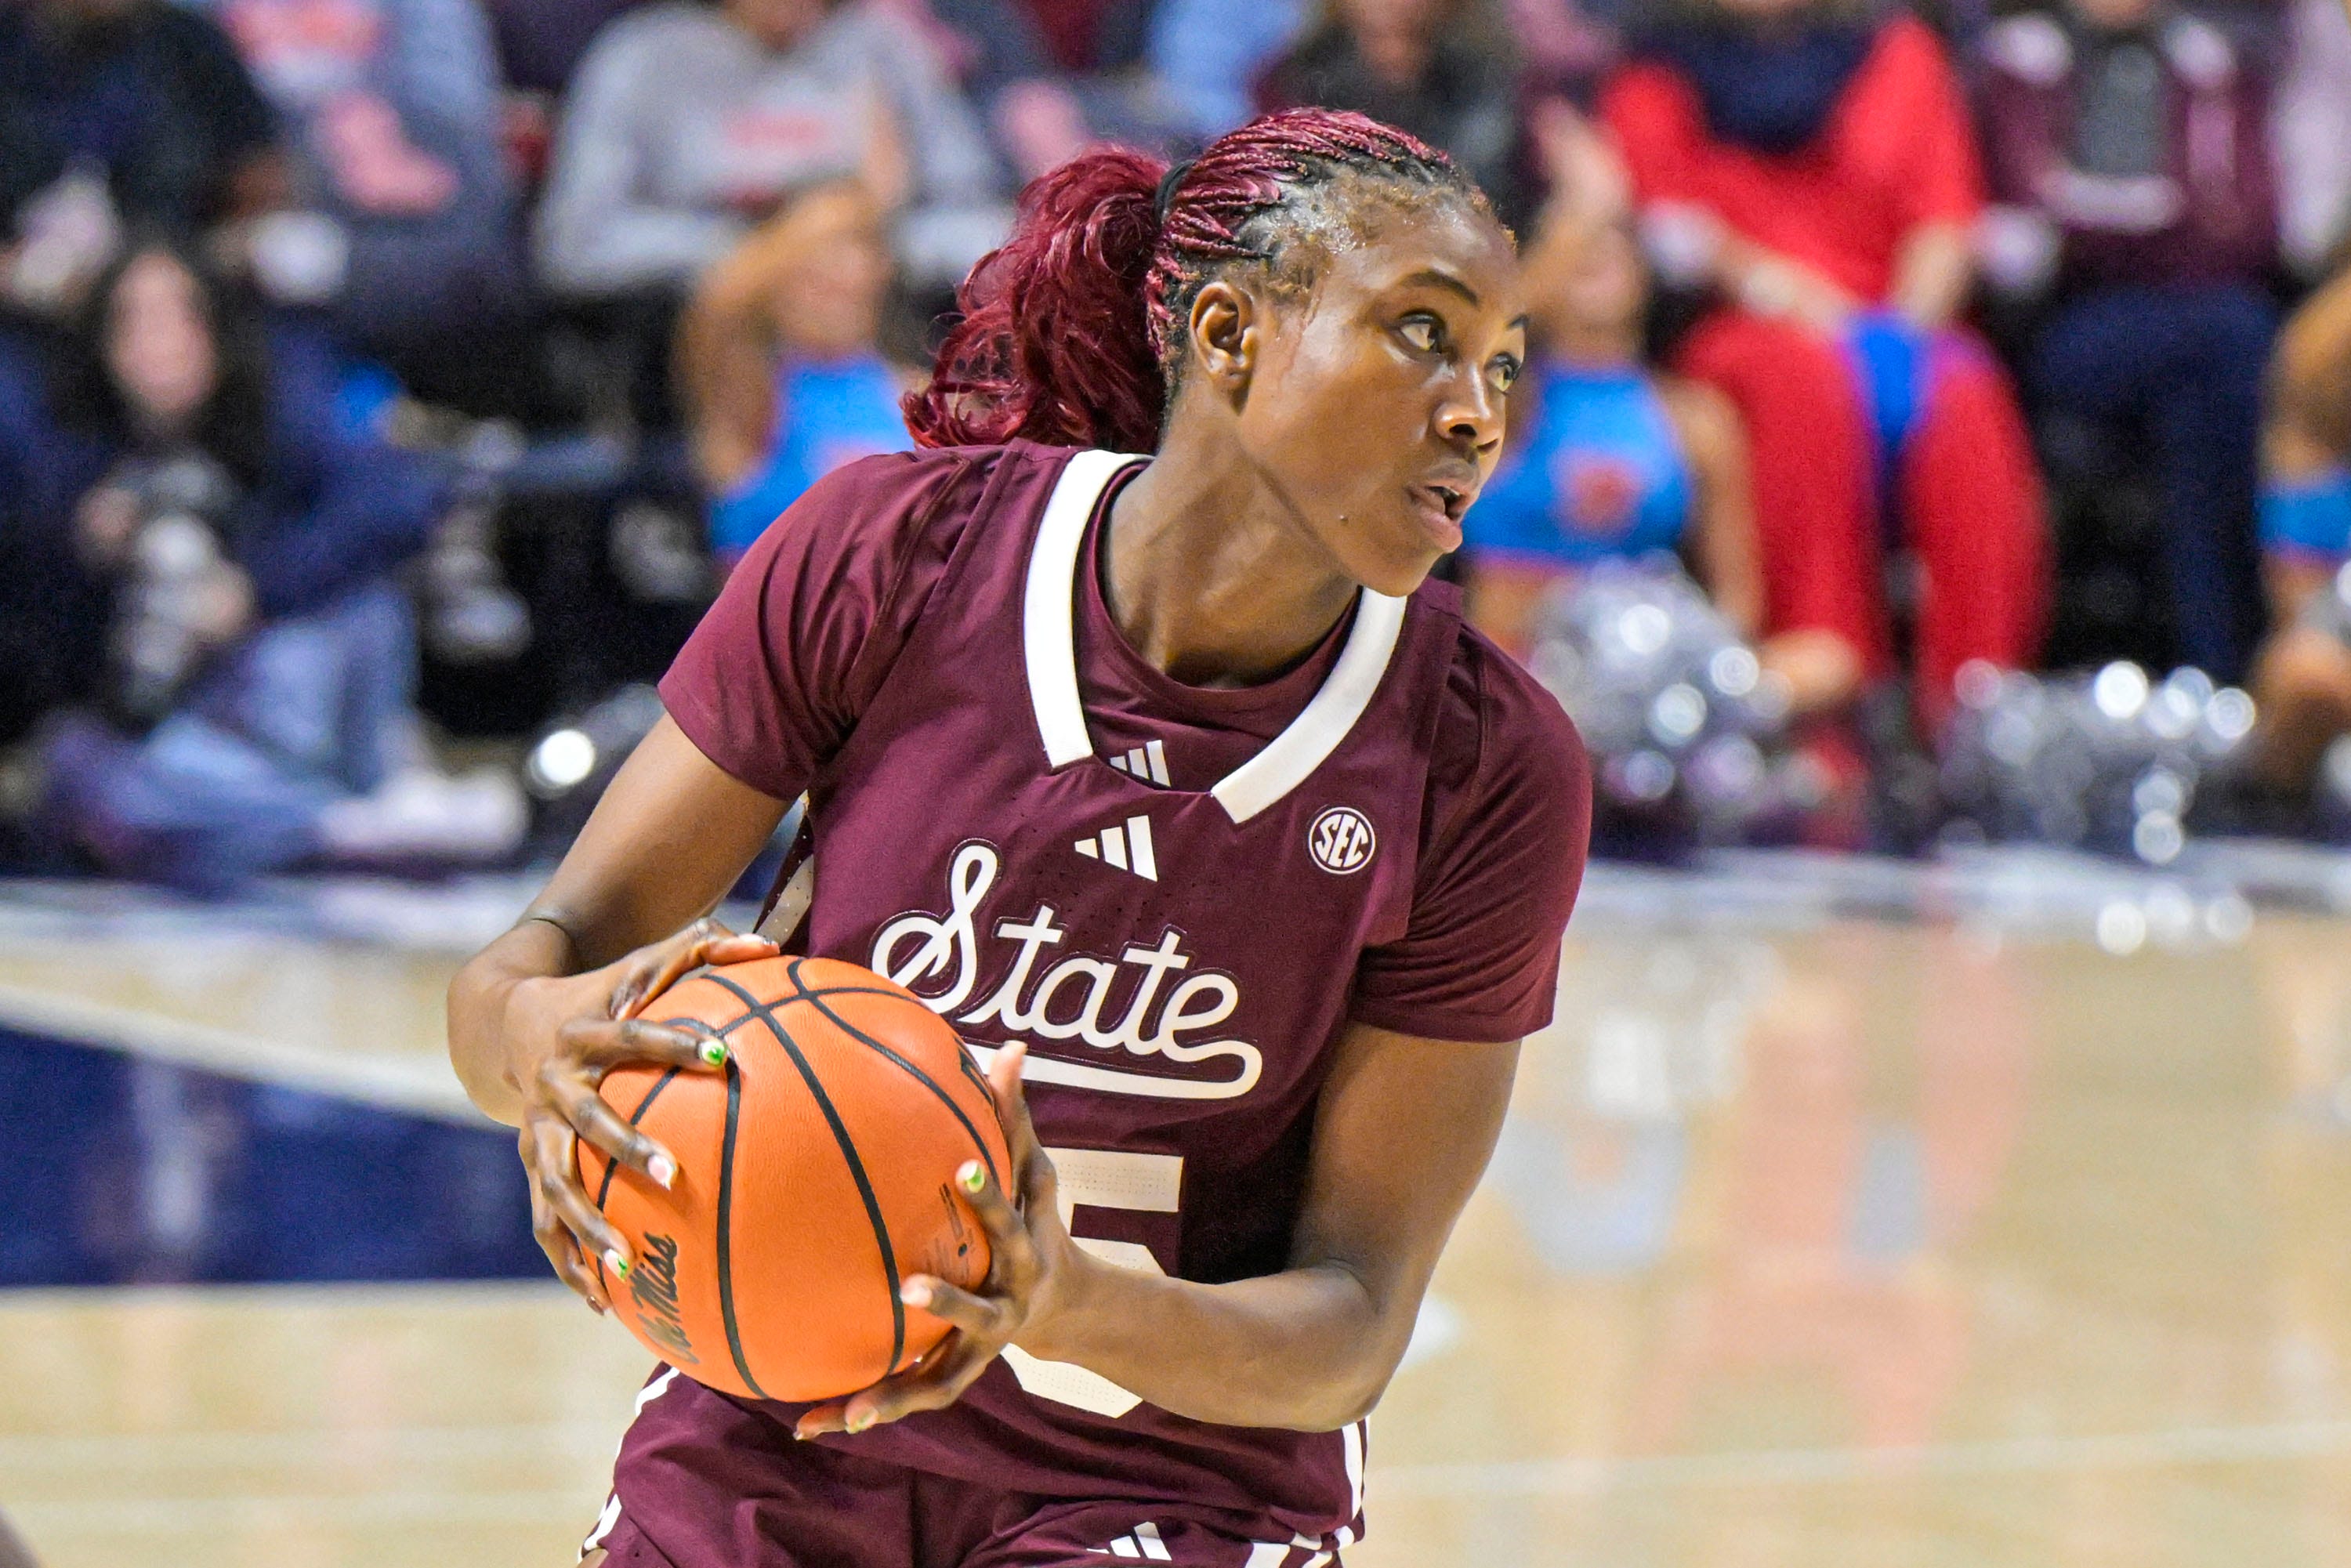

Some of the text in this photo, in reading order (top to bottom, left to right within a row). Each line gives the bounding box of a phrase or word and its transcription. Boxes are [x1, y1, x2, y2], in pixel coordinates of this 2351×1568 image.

[1315, 813, 1369, 867] SEC
[871, 844, 1263, 1099] State
[629, 1231, 680, 1323] Miss
